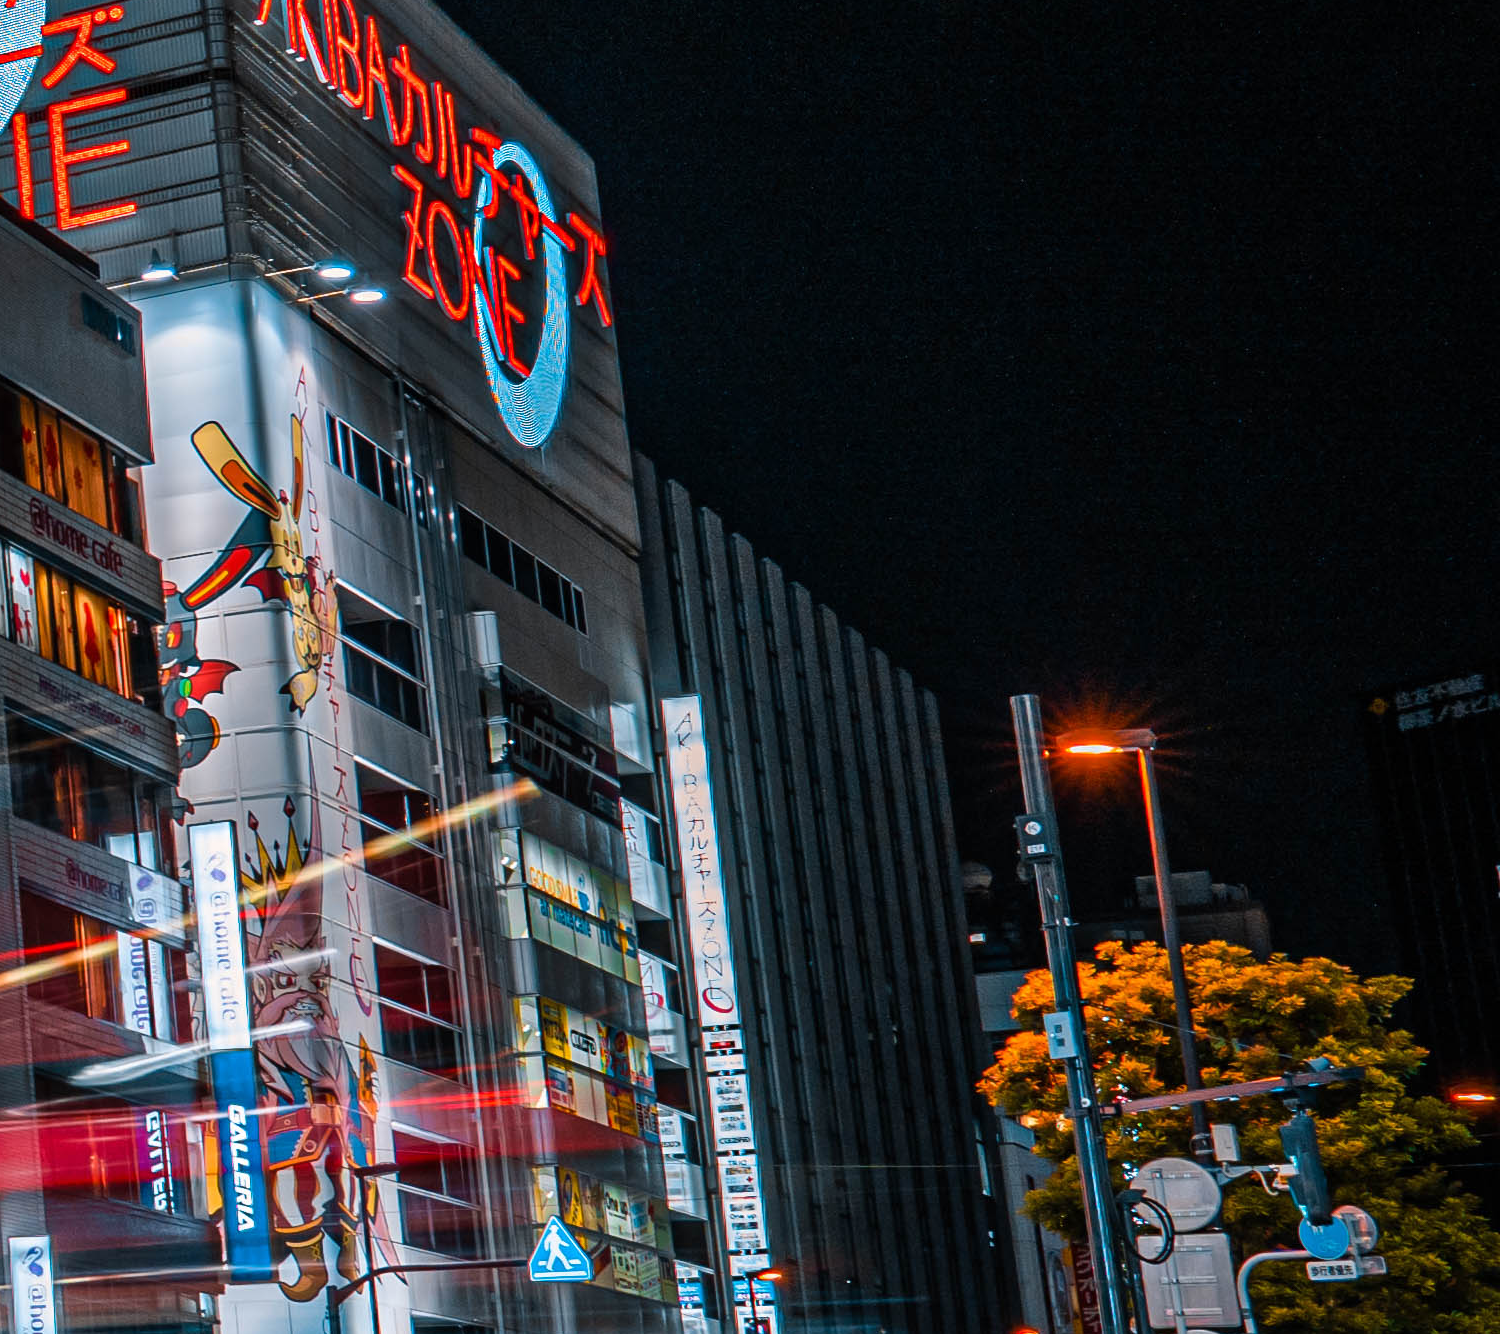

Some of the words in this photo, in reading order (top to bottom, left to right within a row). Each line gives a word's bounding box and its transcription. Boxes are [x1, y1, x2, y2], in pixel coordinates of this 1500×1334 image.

[391, 165, 531, 377] ZONE
[91, 539, 125, 579] cafe
[219, 974, 238, 1022] cafe
[229, 1103, 256, 1232] GALLERIA
